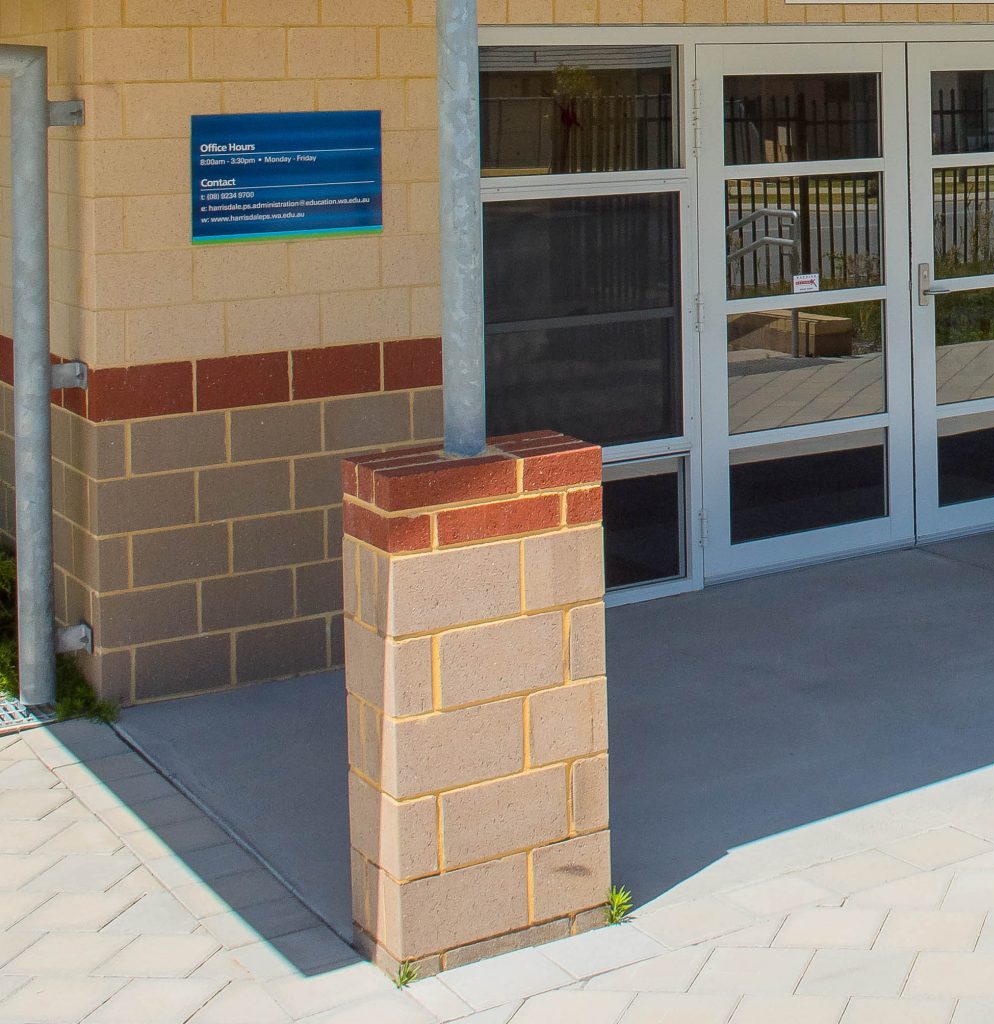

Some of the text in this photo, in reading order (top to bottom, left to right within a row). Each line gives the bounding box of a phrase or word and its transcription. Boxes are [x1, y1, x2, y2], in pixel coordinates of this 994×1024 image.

[200, 143, 256, 153] Office Hours
[200, 158, 225, 166] 8:00am
[230, 157, 256, 165] 3:30pm
[264, 156, 292, 164] Monday
[296, 155, 317, 163] Friday
[200, 178, 236, 187] Contact
[207, 193, 220, 201] (08)
